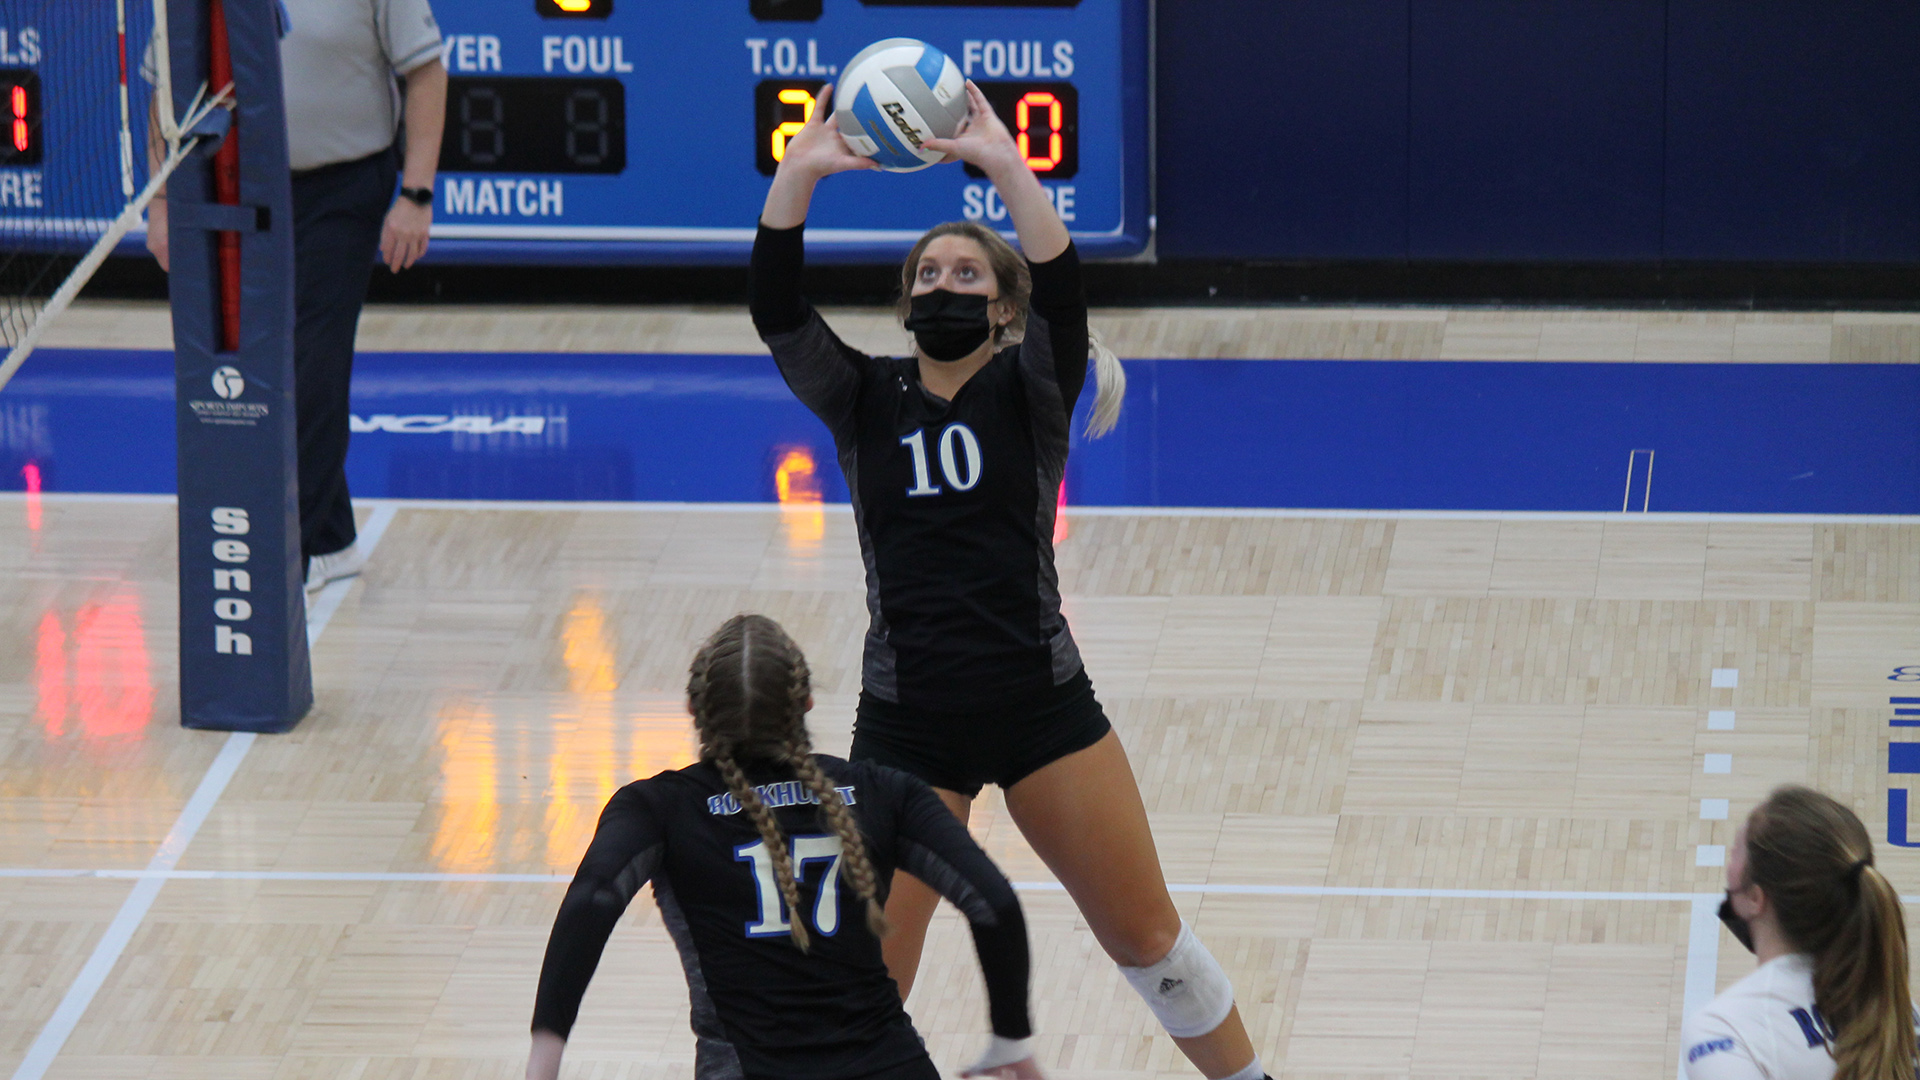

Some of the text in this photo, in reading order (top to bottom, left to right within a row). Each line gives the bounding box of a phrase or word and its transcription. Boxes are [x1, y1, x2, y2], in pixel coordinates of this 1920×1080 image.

[543, 36, 633, 73] FOUL
[746, 39, 837, 75] T.O.L.
[963, 41, 1074, 76] FOULS
[771, 88, 817, 163] 2
[1017, 92, 1062, 171] 0
[444, 179, 563, 216] MATCH
[963, 184, 1076, 221] SCE
[899, 421, 983, 498] 10
[211, 506, 252, 655] senoh
[733, 834, 841, 938] 17
